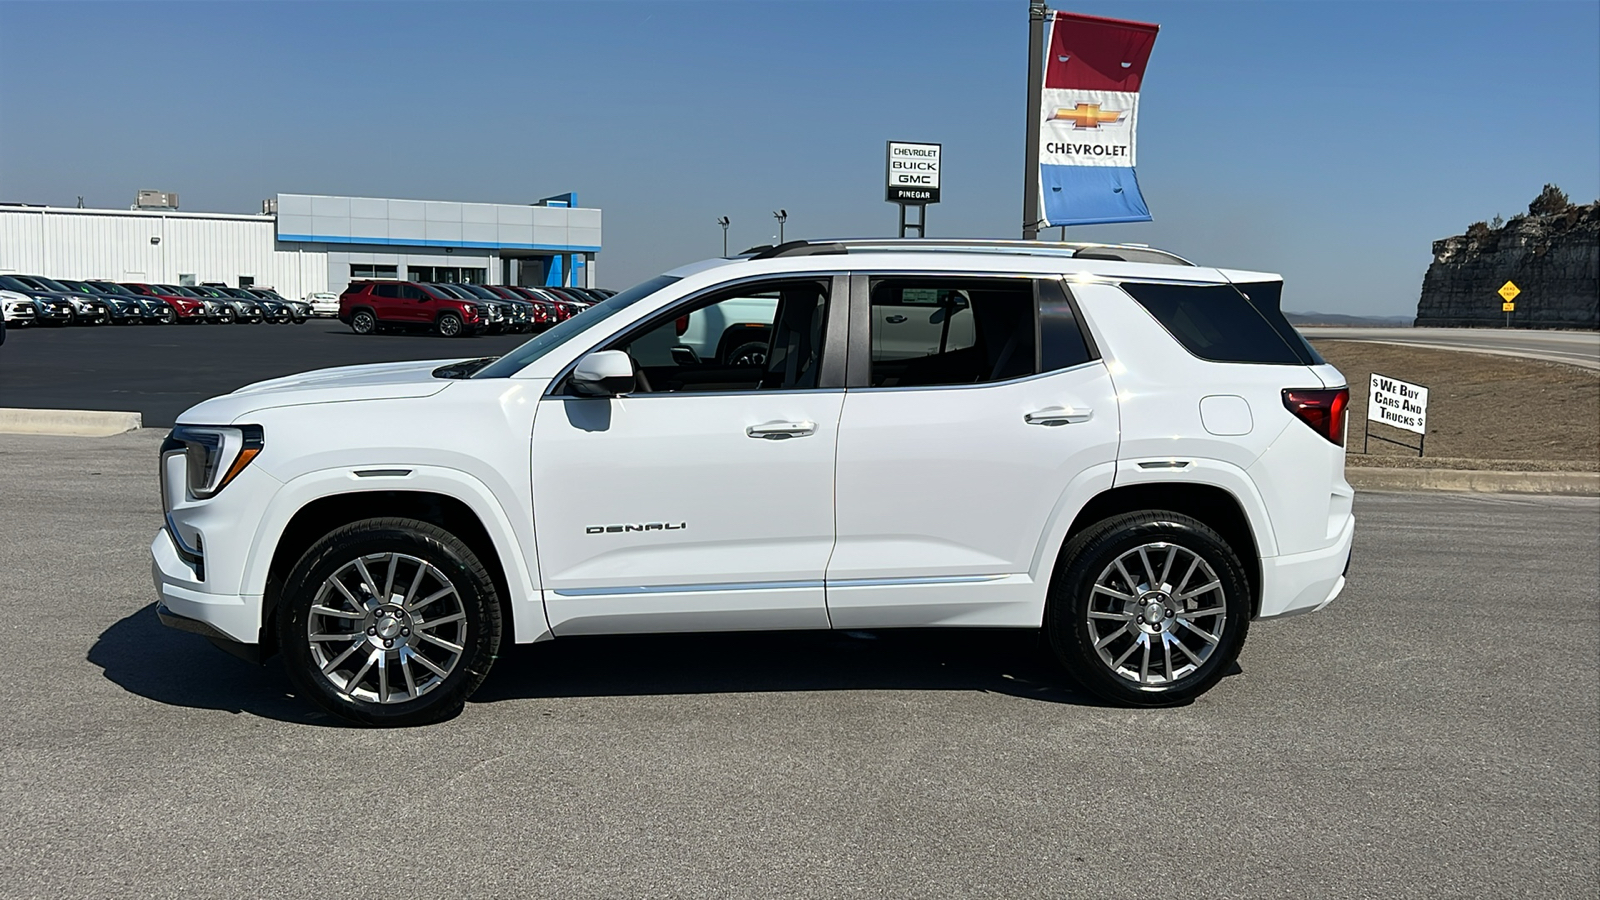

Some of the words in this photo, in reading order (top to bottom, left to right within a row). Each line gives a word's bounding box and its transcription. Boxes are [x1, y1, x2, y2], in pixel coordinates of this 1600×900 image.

[894, 148, 937, 157] CHEVROLET
[1046, 142, 1127, 157] CHEVROLET
[892, 161, 937, 171] BUICK
[898, 175, 931, 184] GMC
[898, 190, 931, 199] PINEGAR
[1400, 384, 1419, 400] BUY
[1375, 391, 1400, 409] CARS
[1402, 399, 1422, 415] AND
[1380, 406, 1415, 427] TRUCKS
[586, 522, 686, 534] DENALI
